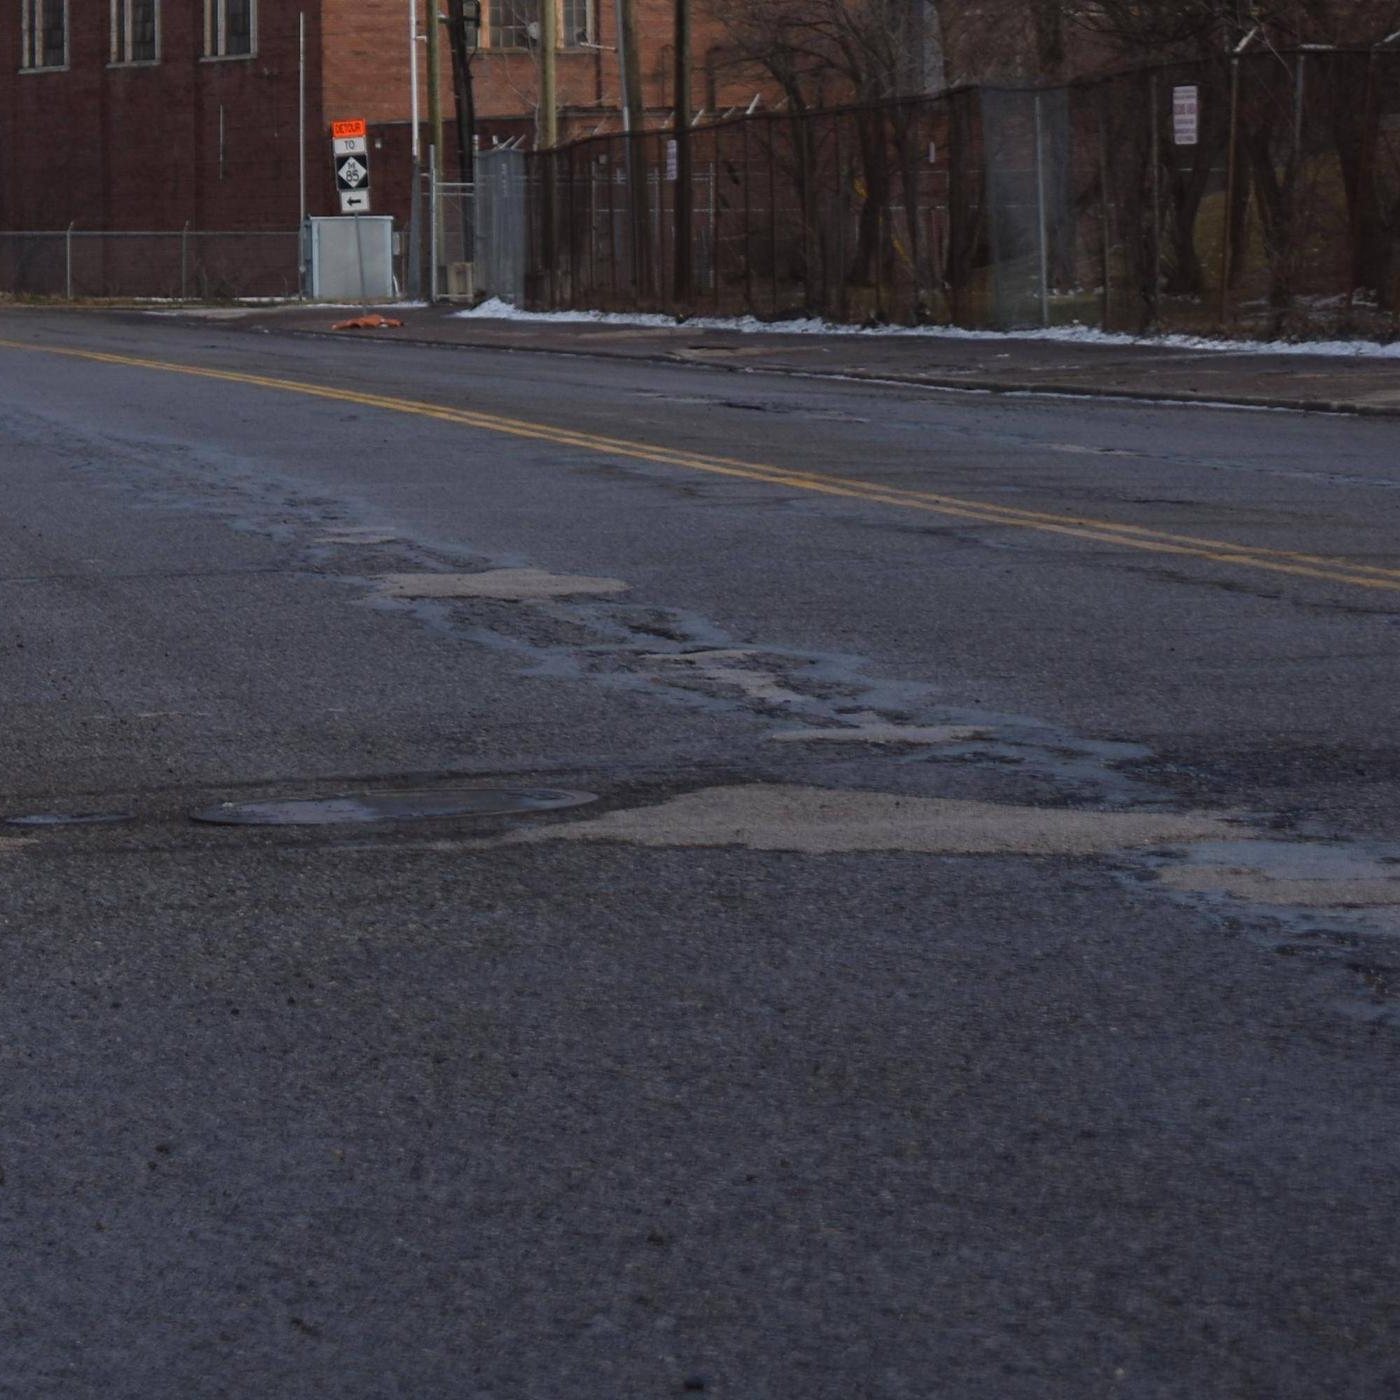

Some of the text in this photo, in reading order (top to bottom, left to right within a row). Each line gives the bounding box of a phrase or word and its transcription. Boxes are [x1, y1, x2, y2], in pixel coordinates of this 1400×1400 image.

[335, 123, 361, 134] DETOUR
[344, 140, 355, 150] TO
[345, 170, 359, 182] 85
